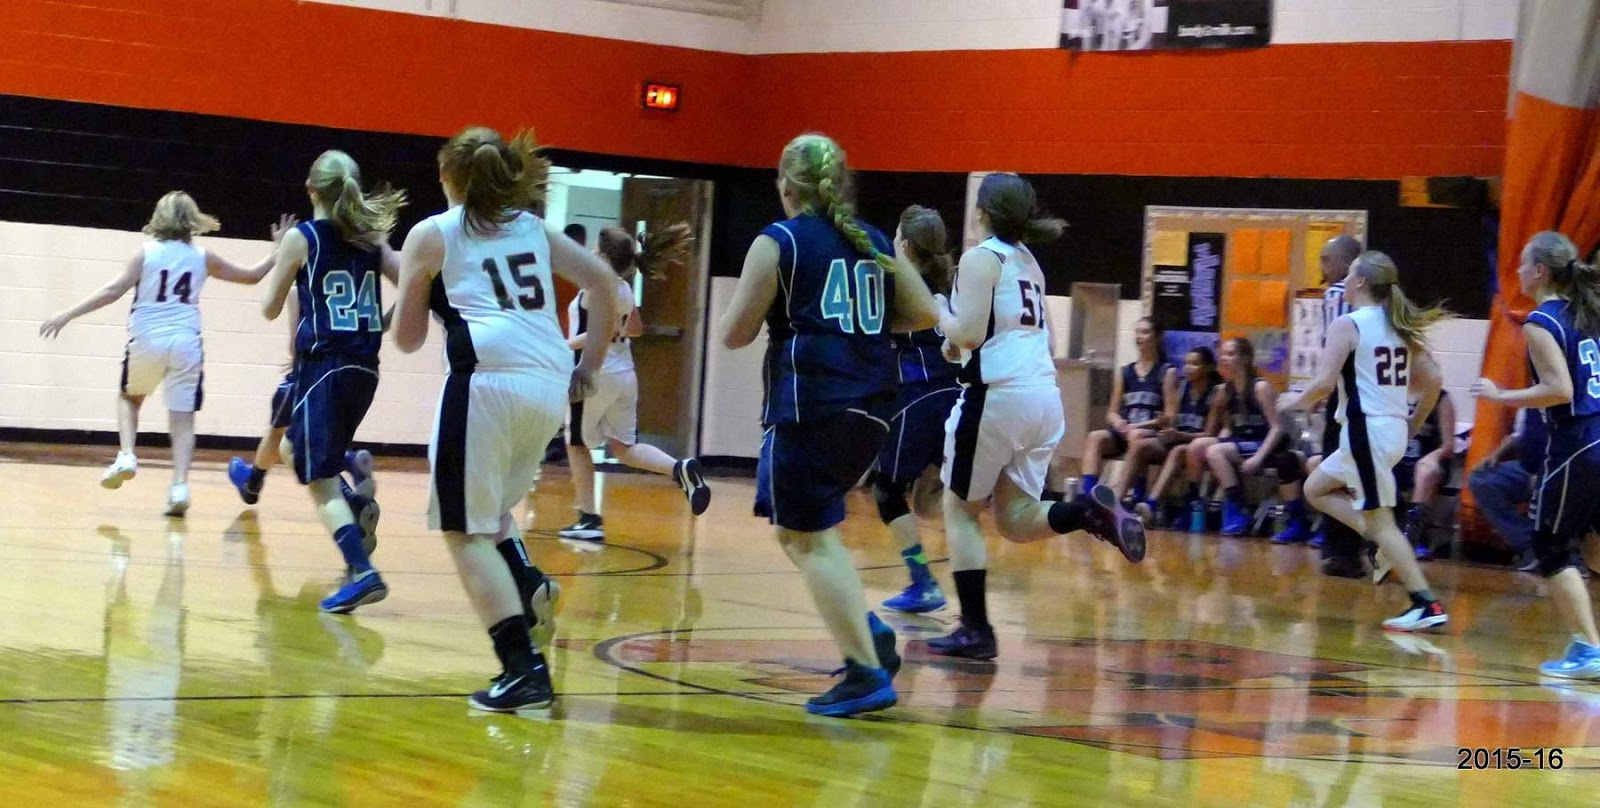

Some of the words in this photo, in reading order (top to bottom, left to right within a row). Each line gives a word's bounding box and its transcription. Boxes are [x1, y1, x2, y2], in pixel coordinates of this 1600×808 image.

[156, 269, 193, 304] 14
[323, 270, 382, 332] 24
[482, 252, 546, 310] 15
[820, 258, 885, 335] 40
[1374, 346, 1408, 386] 22
